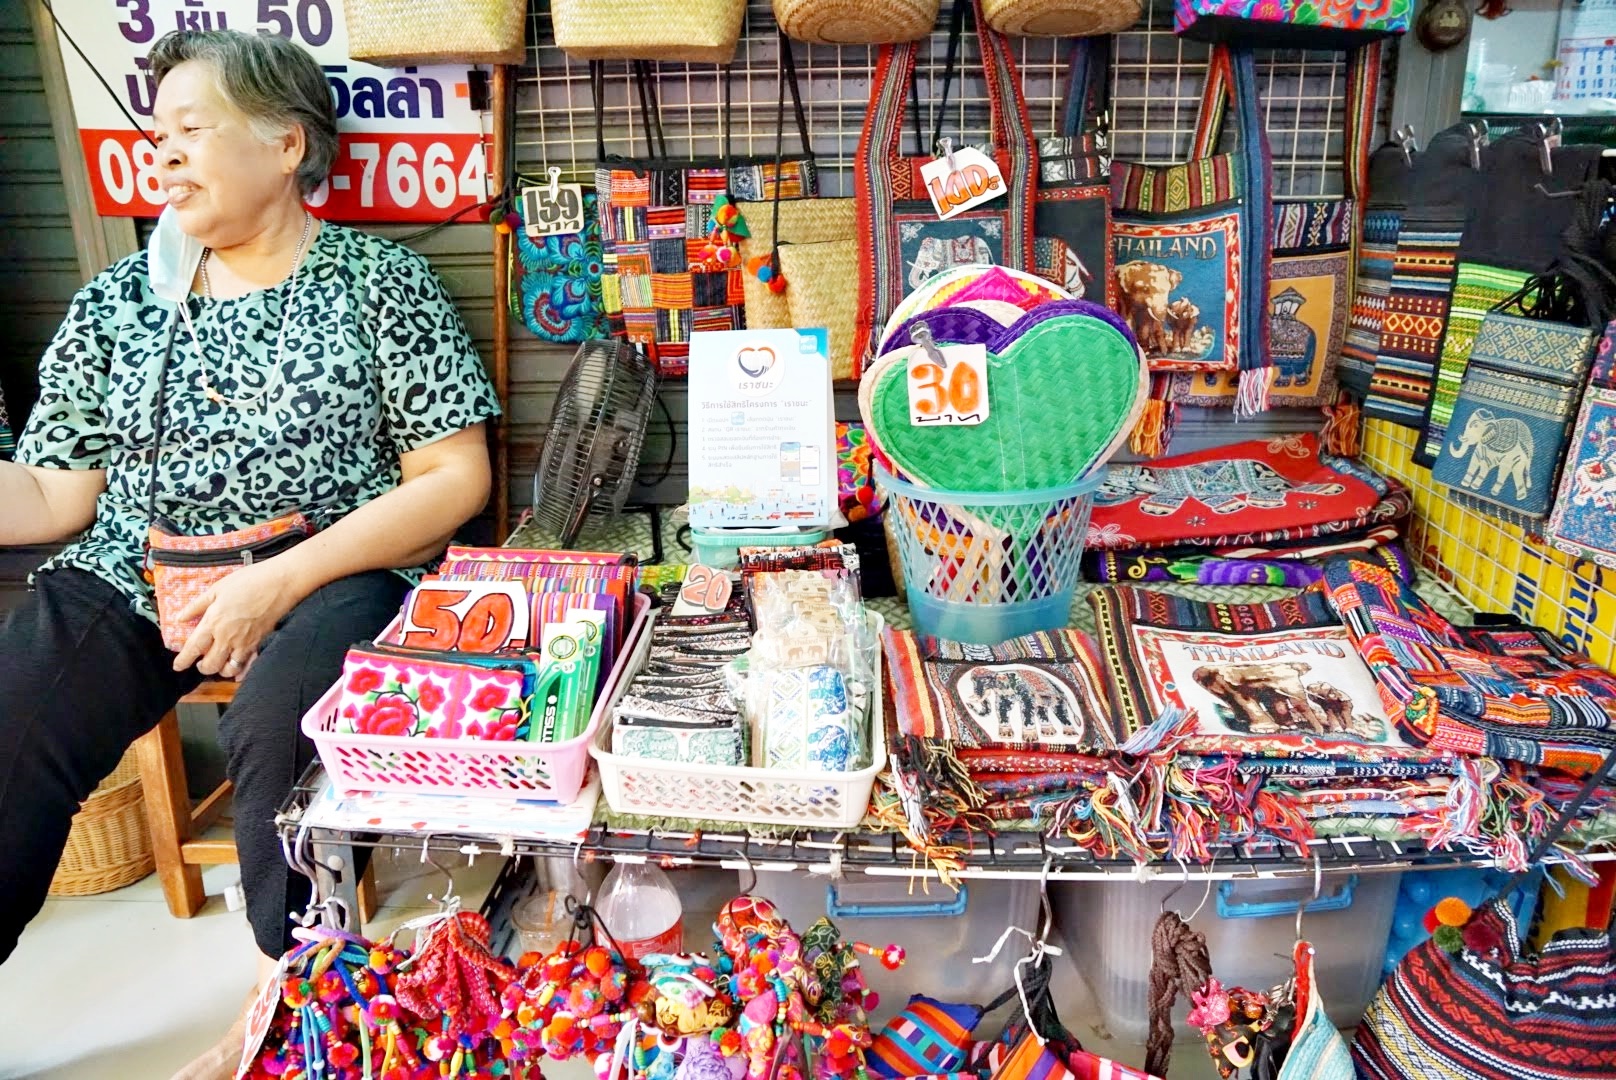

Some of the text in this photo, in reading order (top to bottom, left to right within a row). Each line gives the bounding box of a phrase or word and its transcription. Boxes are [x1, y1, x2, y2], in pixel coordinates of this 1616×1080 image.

[116, 0, 155, 44] 3
[257, 0, 333, 47] 50
[304, 142, 493, 209] -7664
[524, 188, 580, 226] 159
[1113, 237, 1217, 260] HAILAND
[910, 361, 980, 415] 30
[915, 413, 981, 423] บาท
[681, 564, 733, 613] 20
[1182, 640, 1346, 664] THAILAND
